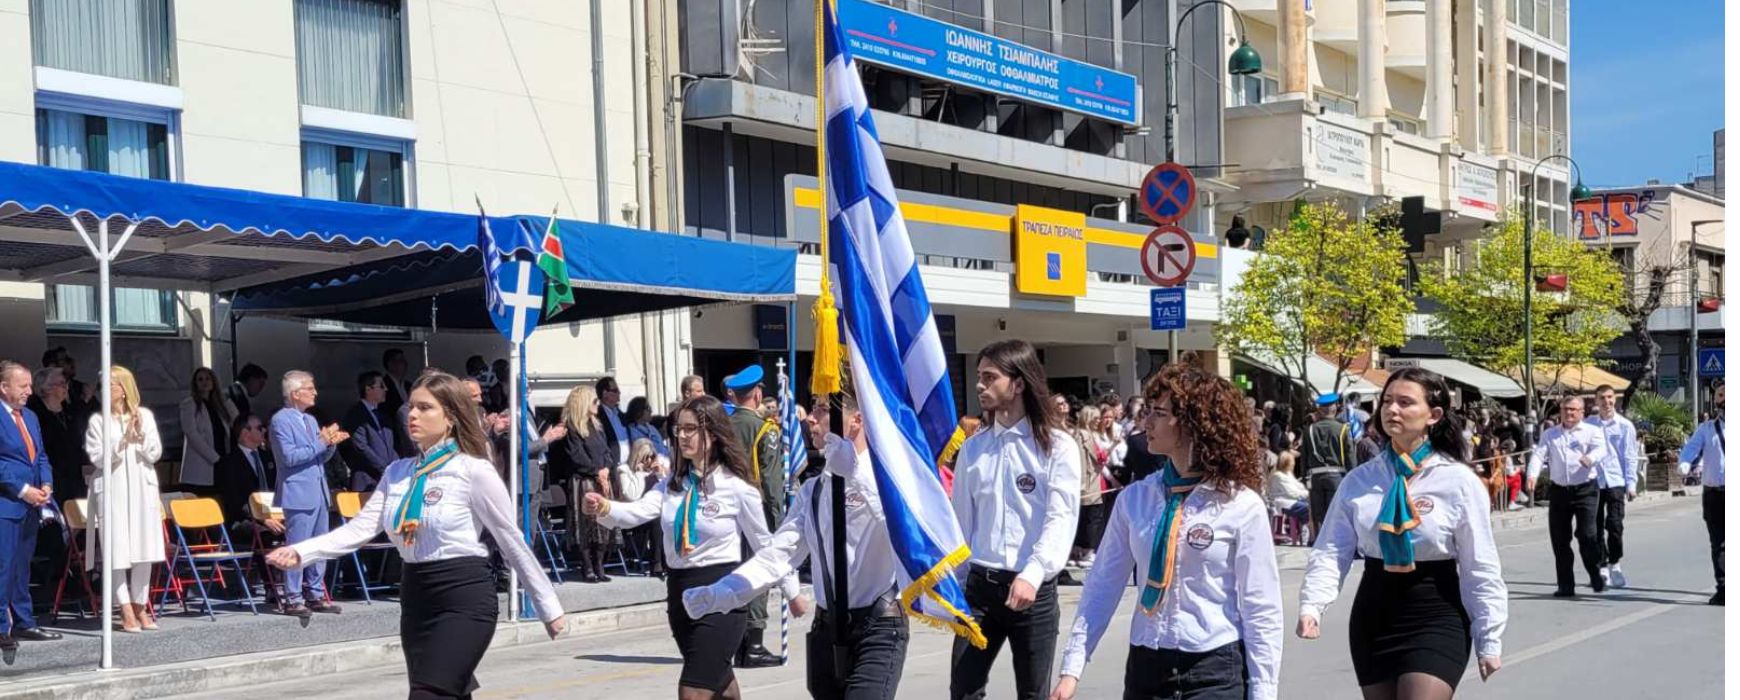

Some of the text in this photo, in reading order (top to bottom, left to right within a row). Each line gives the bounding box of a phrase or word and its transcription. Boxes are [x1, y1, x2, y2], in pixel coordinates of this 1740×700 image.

[945, 29, 1059, 74] ΙΩΑΝΝΗΣ ΤΣΙΑΜΠΑΛΗΣ
[946, 51, 997, 74] ΧΕΙΡΟΥΡΓΟΣ
[1000, 65, 1059, 90] ΟΦΘΑΛΜΙΑΤΡΟΣ
[1023, 220, 1083, 240] ΤΡΑΠΕΖΑ ΠΕΙΡΑΙΩΣ
[1155, 306, 1181, 317] ΤΑΞΙ
